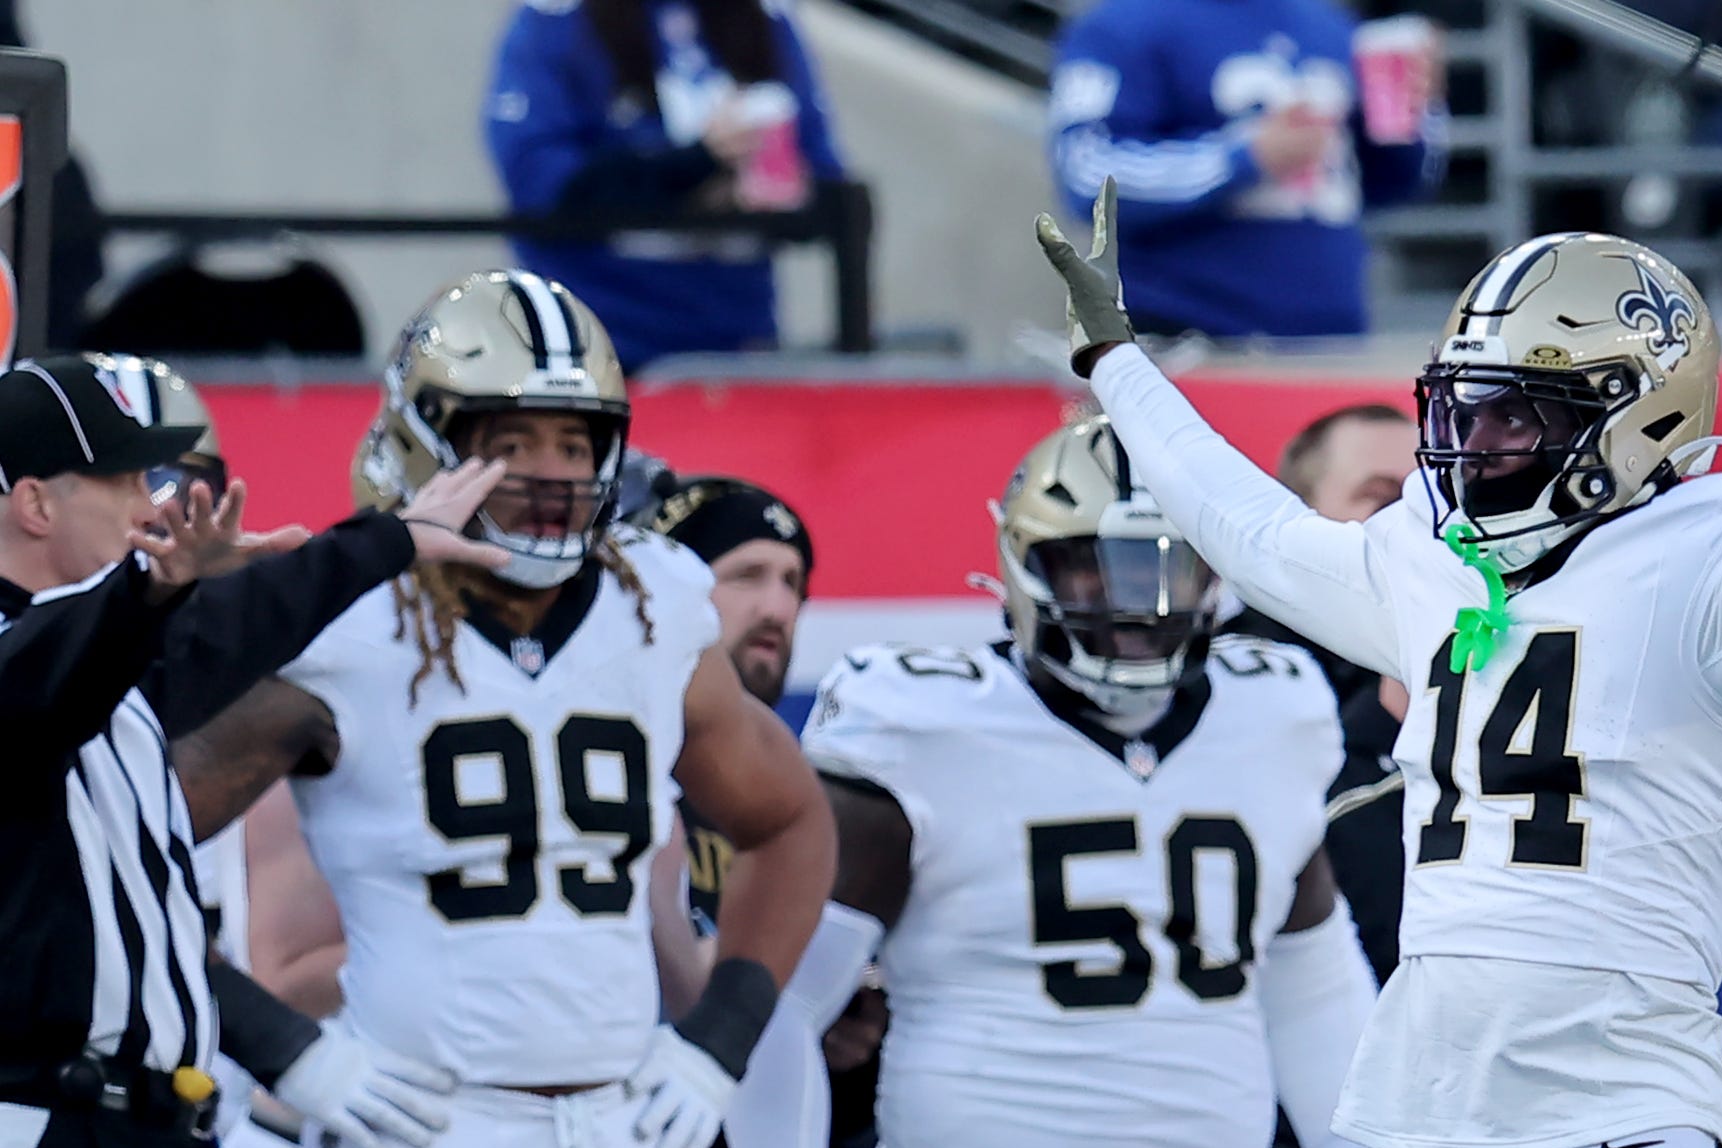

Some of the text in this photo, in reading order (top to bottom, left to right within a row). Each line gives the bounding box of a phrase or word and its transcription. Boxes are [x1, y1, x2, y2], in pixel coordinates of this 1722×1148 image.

[1451, 339, 1486, 351] SAINTS
[420, 710, 653, 925] 99
[1412, 624, 1593, 874] 14
[1026, 810, 1260, 1014] 50
